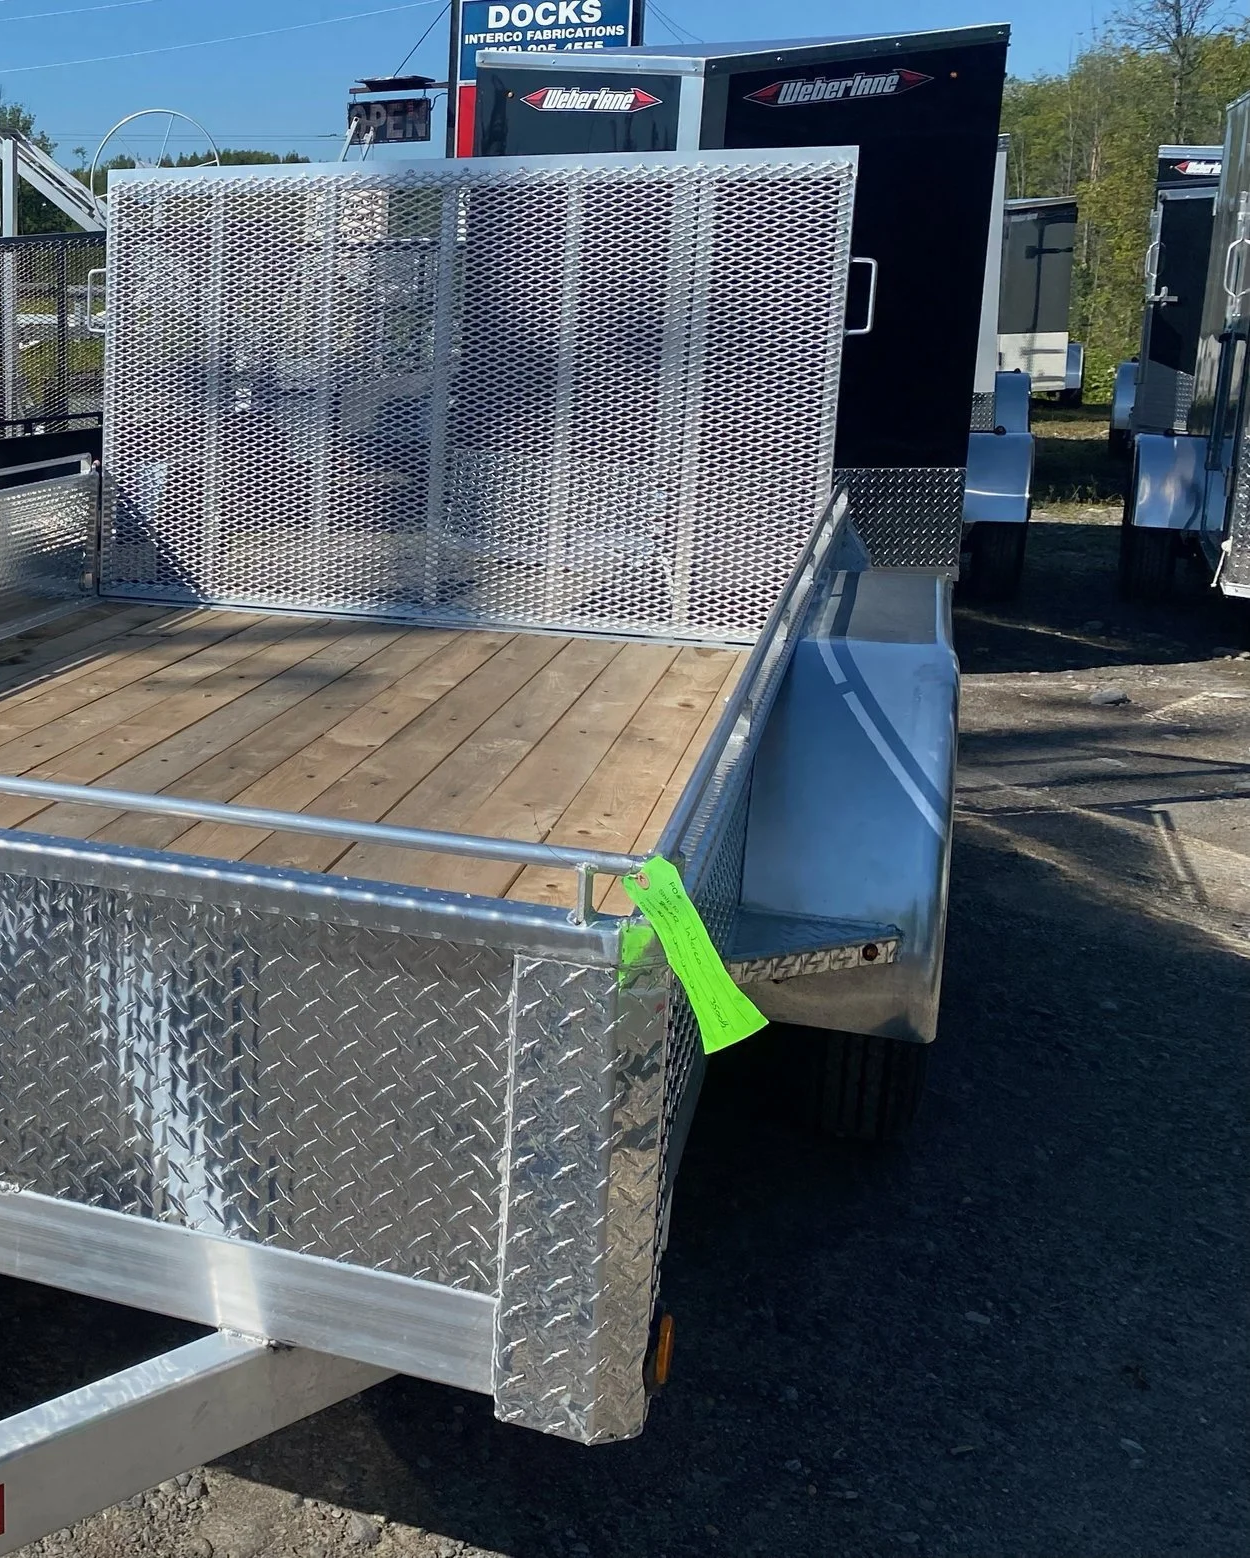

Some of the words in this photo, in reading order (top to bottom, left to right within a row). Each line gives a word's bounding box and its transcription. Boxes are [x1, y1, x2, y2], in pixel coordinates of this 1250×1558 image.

[488, 0, 602, 29] DOCKS
[464, 32, 523, 45] INTERCO
[526, 25, 625, 41] FABRICATIONS
[541, 89, 636, 110] Weberlane
[777, 74, 900, 105] Weberlane
[349, 101, 426, 141] OPEN
